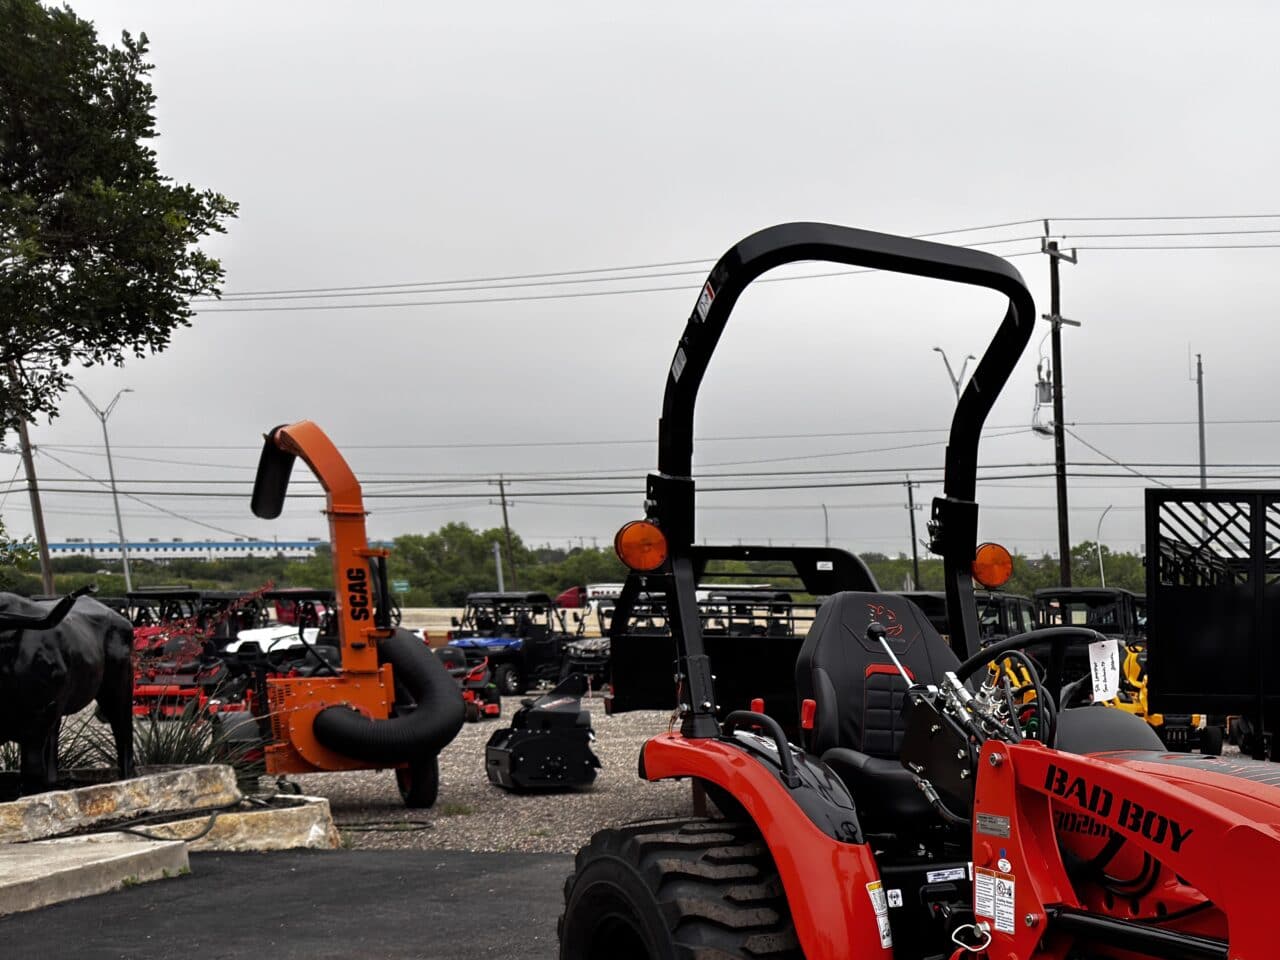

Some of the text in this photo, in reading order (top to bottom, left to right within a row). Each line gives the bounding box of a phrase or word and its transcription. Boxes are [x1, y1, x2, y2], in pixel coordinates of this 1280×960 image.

[347, 567, 370, 621] SCAG
[1043, 763, 1193, 852] BAD BOY
